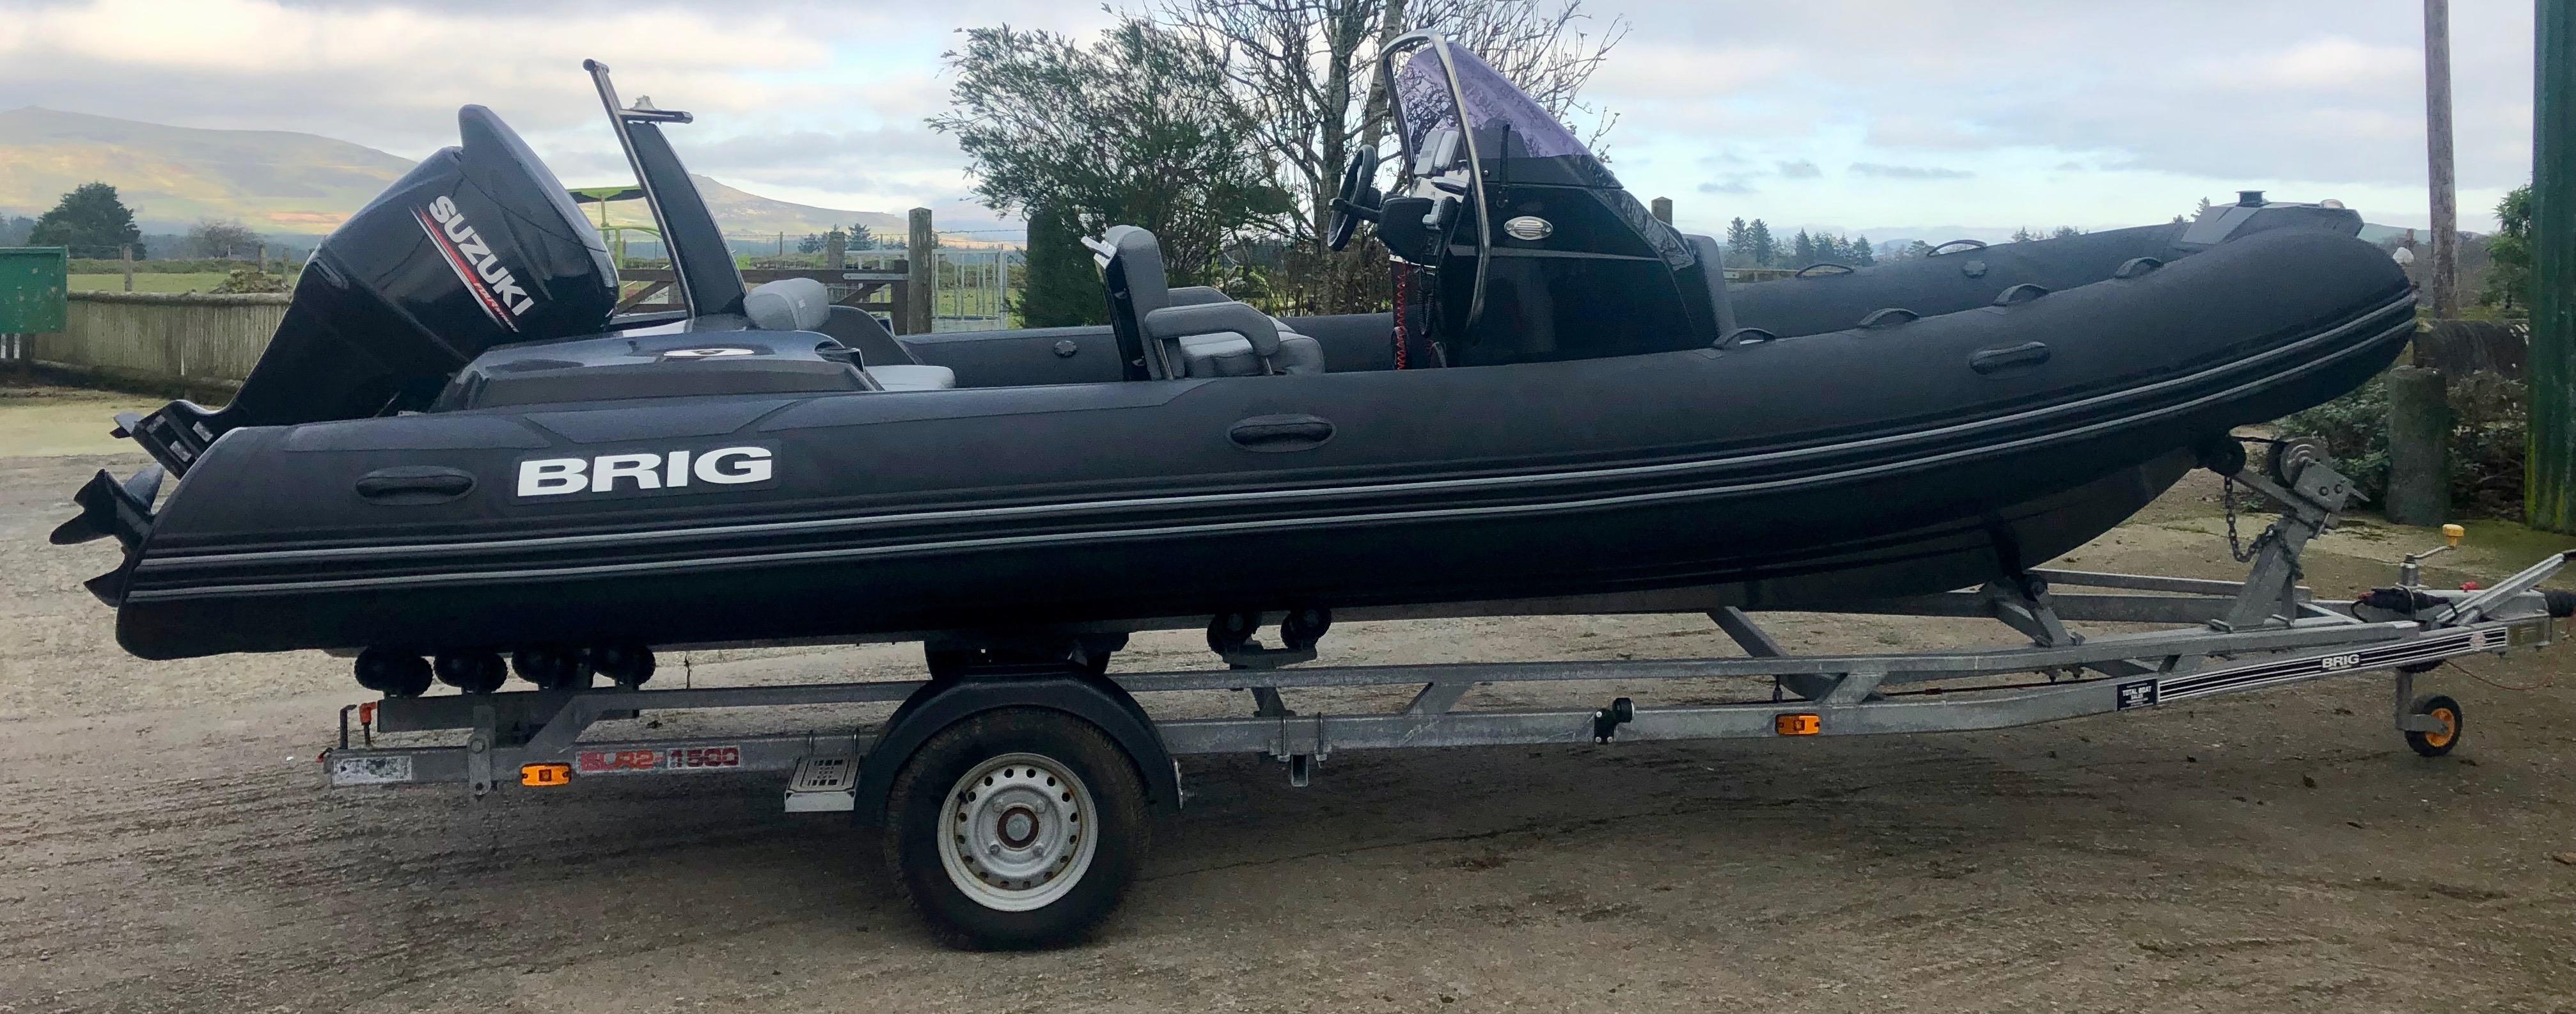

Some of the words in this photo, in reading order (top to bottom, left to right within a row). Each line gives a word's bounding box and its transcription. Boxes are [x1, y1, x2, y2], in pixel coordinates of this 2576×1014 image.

[429, 196, 534, 315] SUZUKI
[517, 447, 772, 496] BRIG
[2322, 654, 2360, 669] BRIG
[671, 747, 739, 768] 1500
